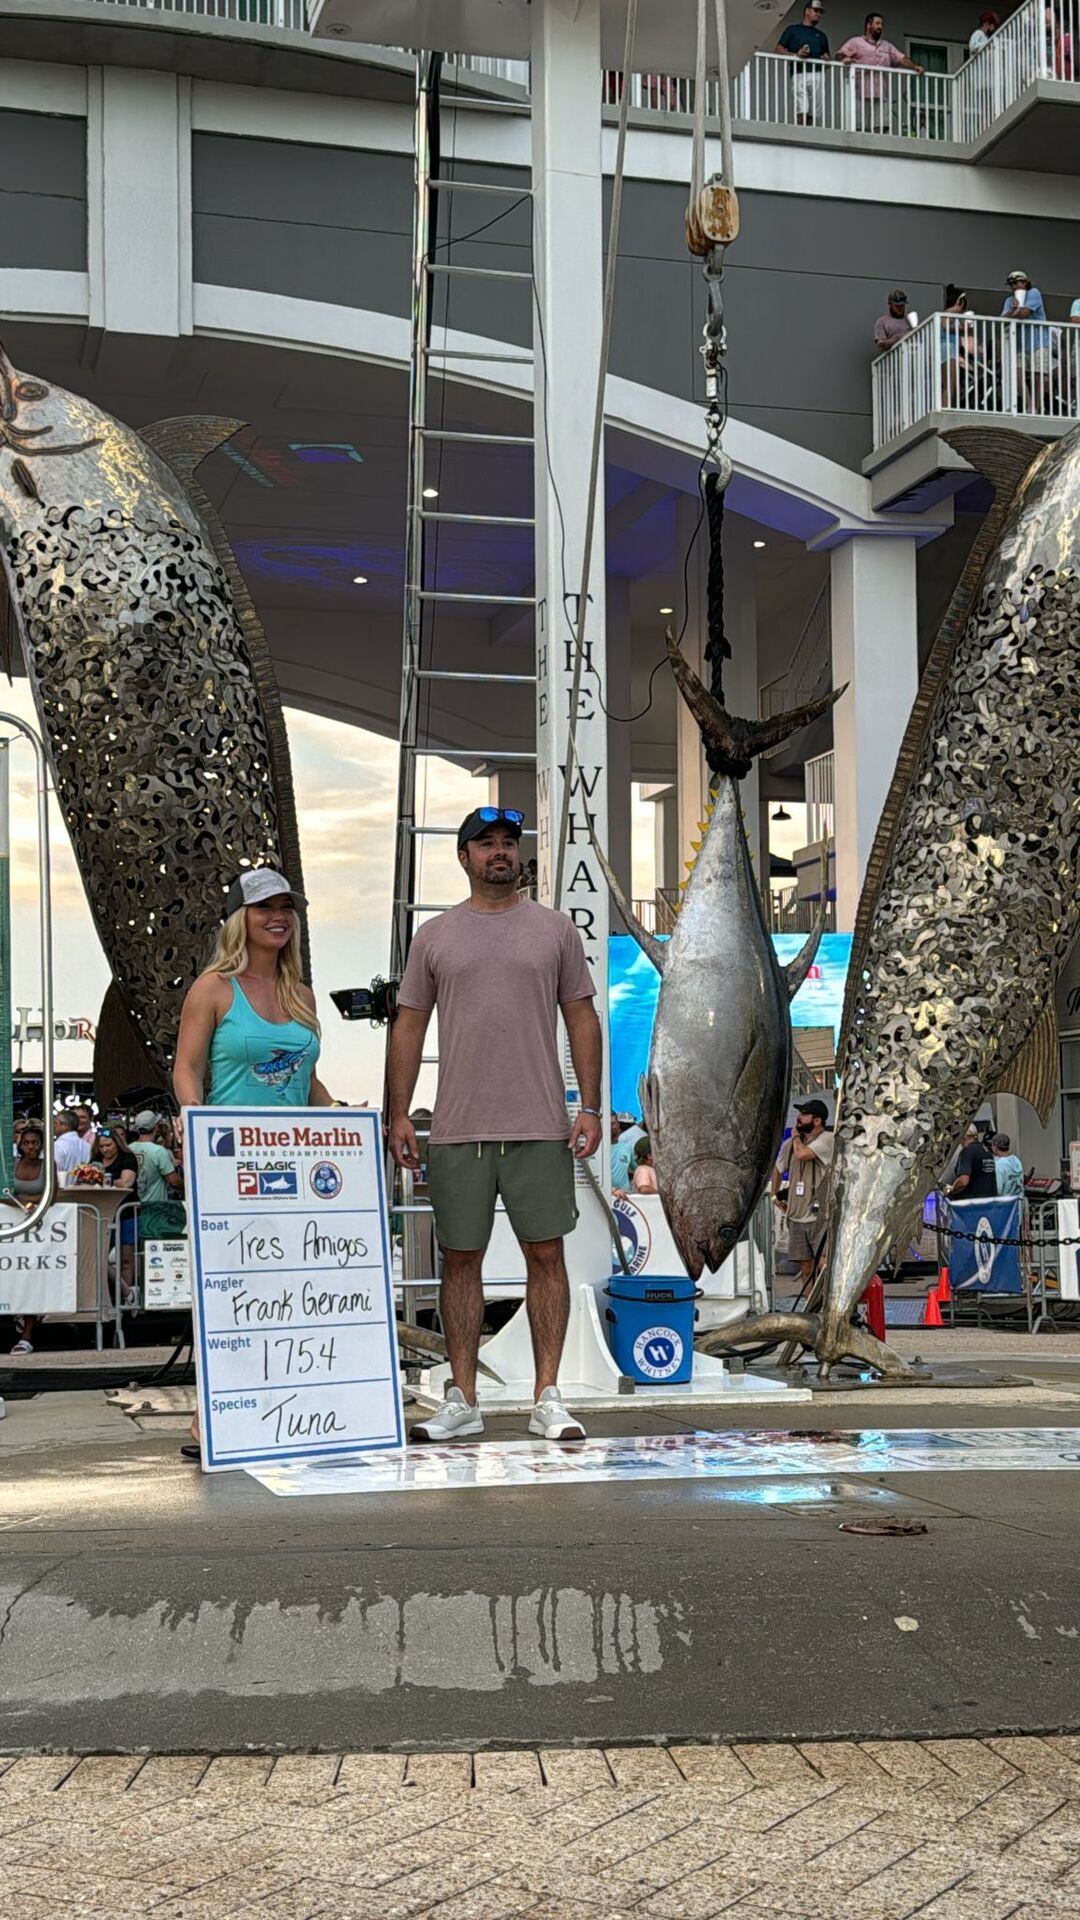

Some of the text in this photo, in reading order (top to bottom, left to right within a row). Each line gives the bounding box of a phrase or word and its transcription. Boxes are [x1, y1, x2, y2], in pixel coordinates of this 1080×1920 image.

[537, 598, 550, 898] THE WHA
[558, 592, 603, 965] THE WHAR
[239, 1127, 362, 1147] Blue Marlin
[236, 1161, 296, 1171] PELAGIC
[612, 1199, 637, 1218] GULF
[201, 1219, 230, 1231] Boat
[228, 1220, 368, 1268] Tres Amigos
[629, 1245, 647, 1274] ARINE
[204, 1276, 244, 1292] Angler
[232, 1280, 373, 1326] Frank Gerami
[646, 1291, 673, 1299] HUCK
[208, 1336, 251, 1351] Weight
[635, 1328, 681, 1350] HANCOCK
[264, 1336, 337, 1381] 175.4
[637, 1355, 681, 1376] WHITNEY
[211, 1397, 257, 1414] Species
[261, 1393, 347, 1443] Tuna
